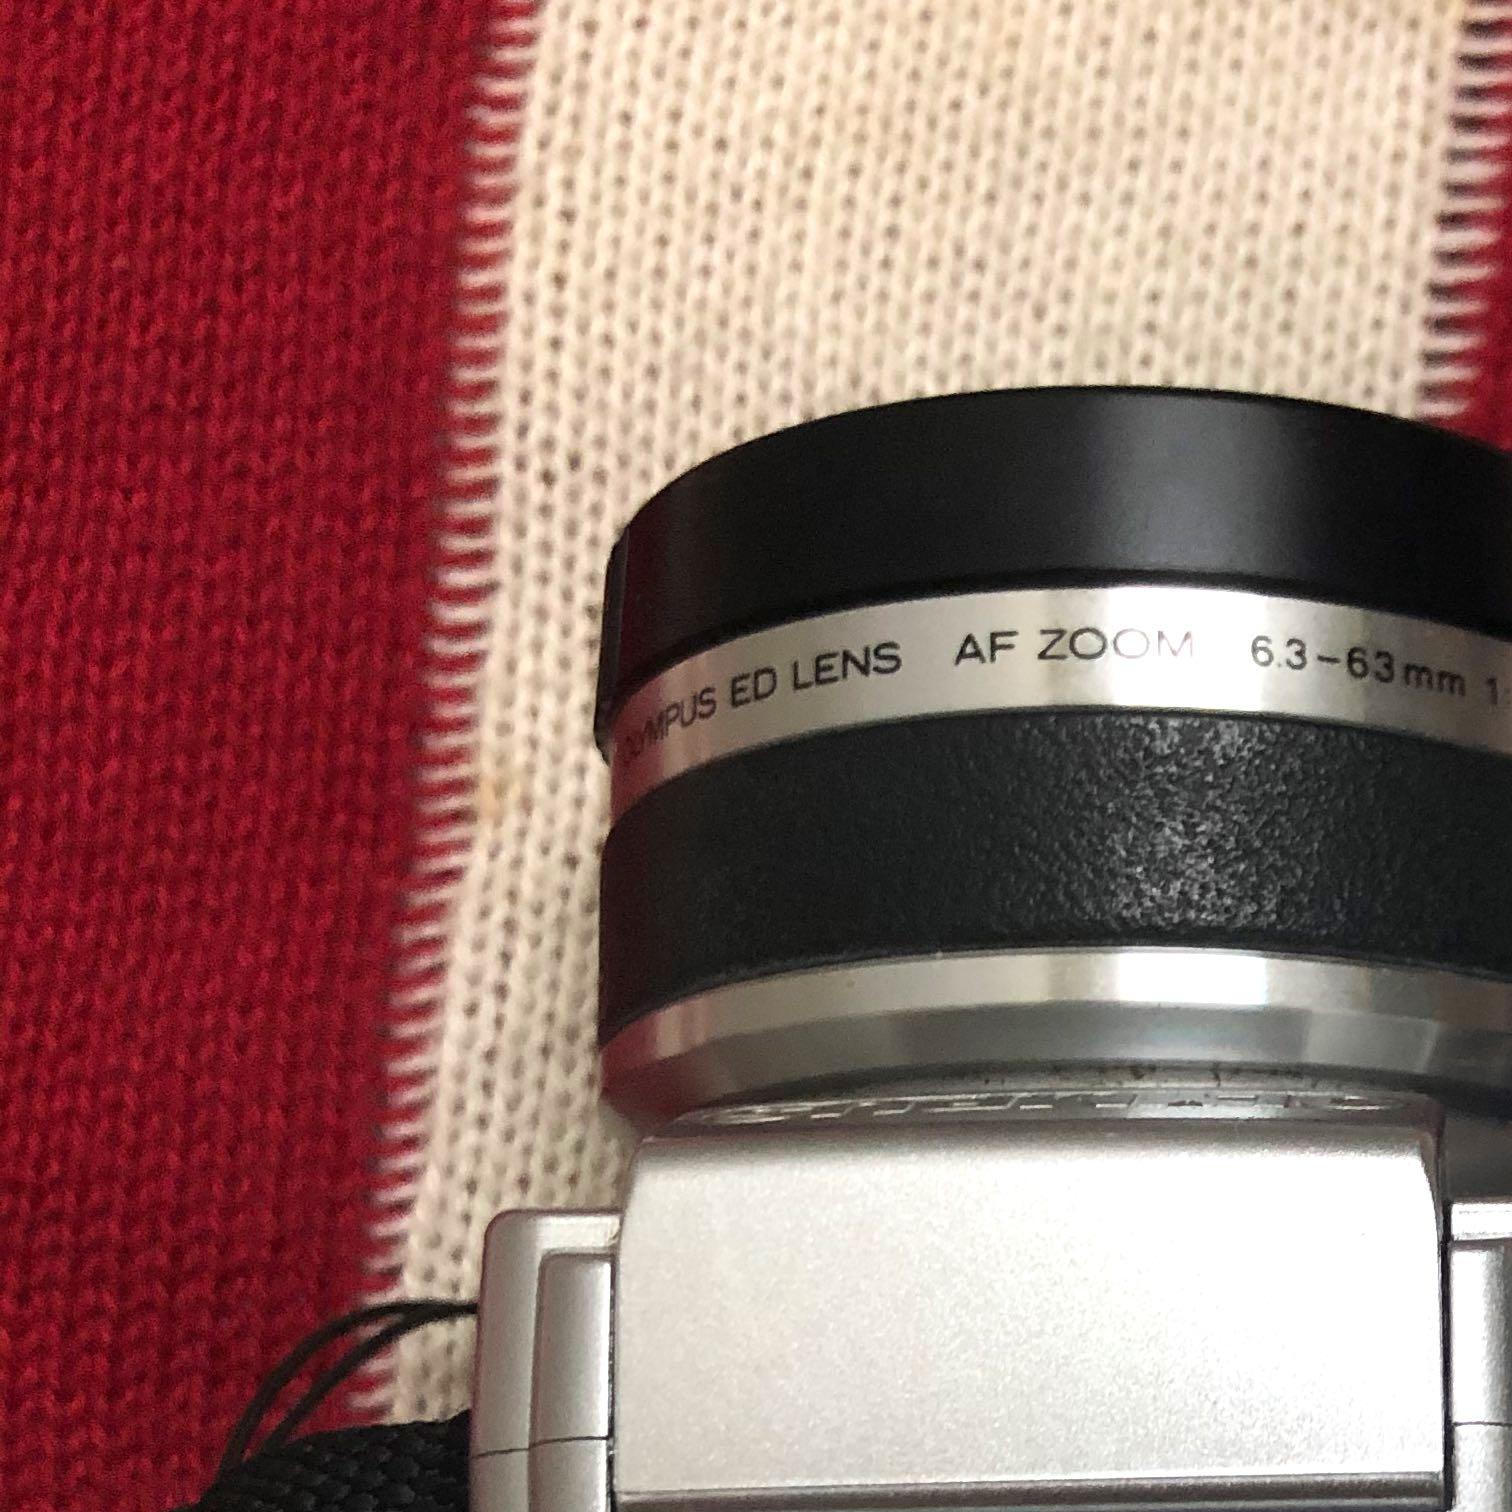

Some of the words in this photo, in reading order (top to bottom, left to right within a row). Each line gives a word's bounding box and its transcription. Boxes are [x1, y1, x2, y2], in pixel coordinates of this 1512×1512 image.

[731, 668, 777, 707] ED
[793, 641, 902, 691] LENS
[954, 630, 1018, 665] AF
[1037, 627, 1195, 660] ZOOM
[1250, 635, 1466, 697] 6.3-63mm
